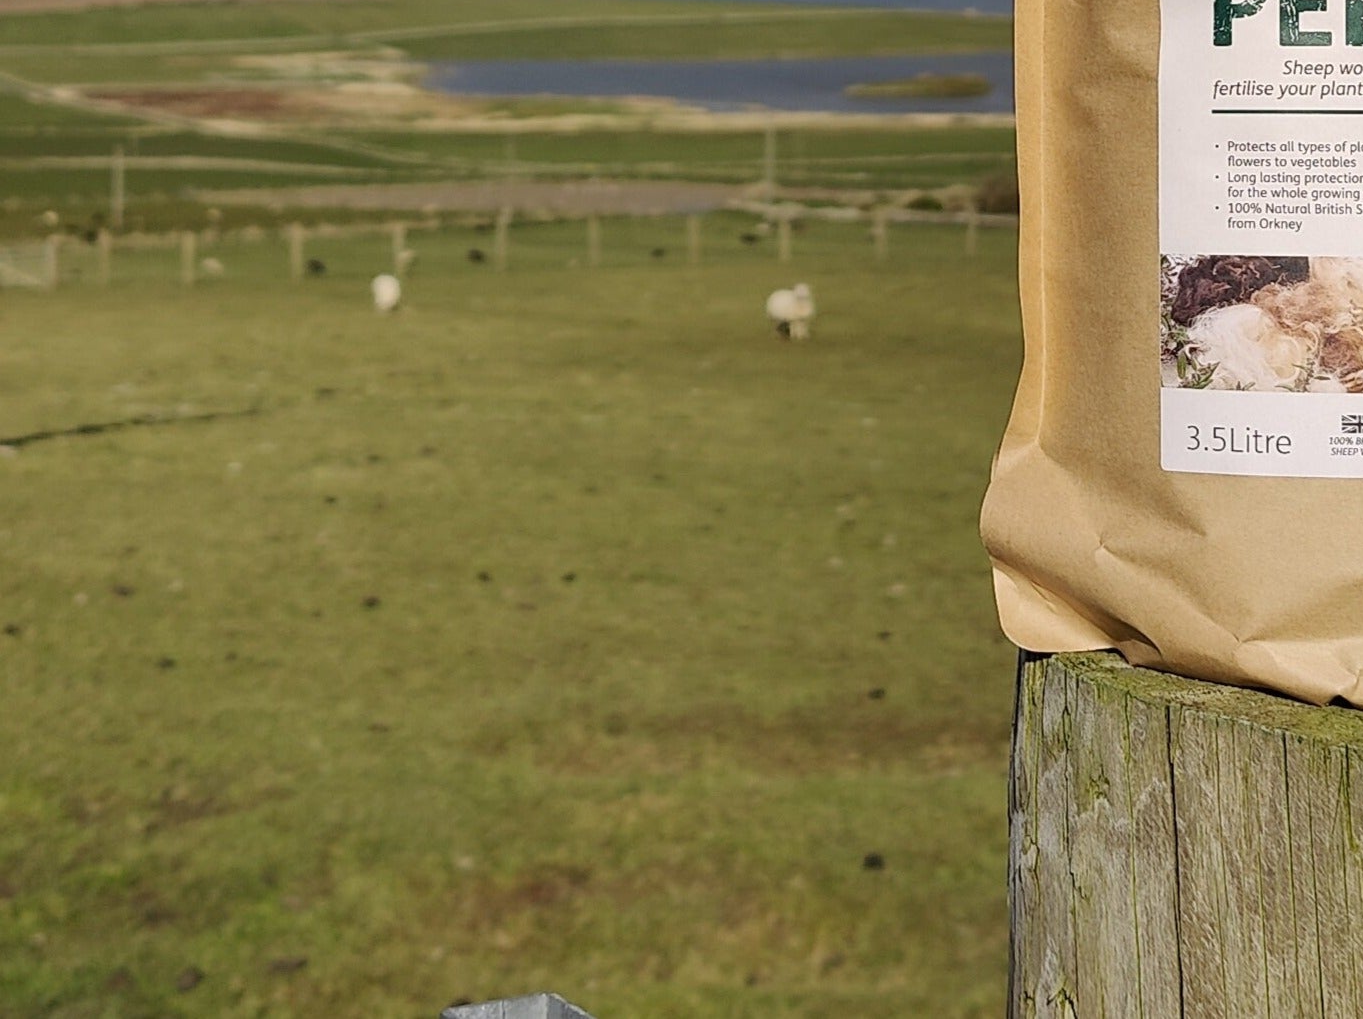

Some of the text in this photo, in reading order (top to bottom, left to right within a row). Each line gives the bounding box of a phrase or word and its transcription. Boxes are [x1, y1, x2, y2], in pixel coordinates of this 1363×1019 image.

[1283, 60, 1334, 79] Sheep
[1213, 80, 1274, 99] fertilise
[1277, 84, 1317, 99] your
[1227, 141, 1276, 152] Protects
[1280, 141, 1294, 152] all
[1299, 143, 1331, 154] types
[1334, 141, 1348, 152] of
[1227, 156, 1357, 170] flowers to vegetables
[1227, 172, 1256, 185] Long
[1260, 172, 1300, 185] lasting
[1227, 187, 1244, 198] for
[1248, 187, 1267, 198] the
[1271, 188, 1308, 198] whole
[1311, 188, 1360, 201] growing
[1228, 203, 1262, 214] 100%
[1265, 204, 1311, 214] Natural
[1315, 204, 1352, 215] British
[1227, 218, 1302, 232] from Orkney
[1187, 425, 1292, 454] 3.5Litre
[1329, 437, 1353, 445] 100%
[1331, 448, 1358, 456] SHEEP
